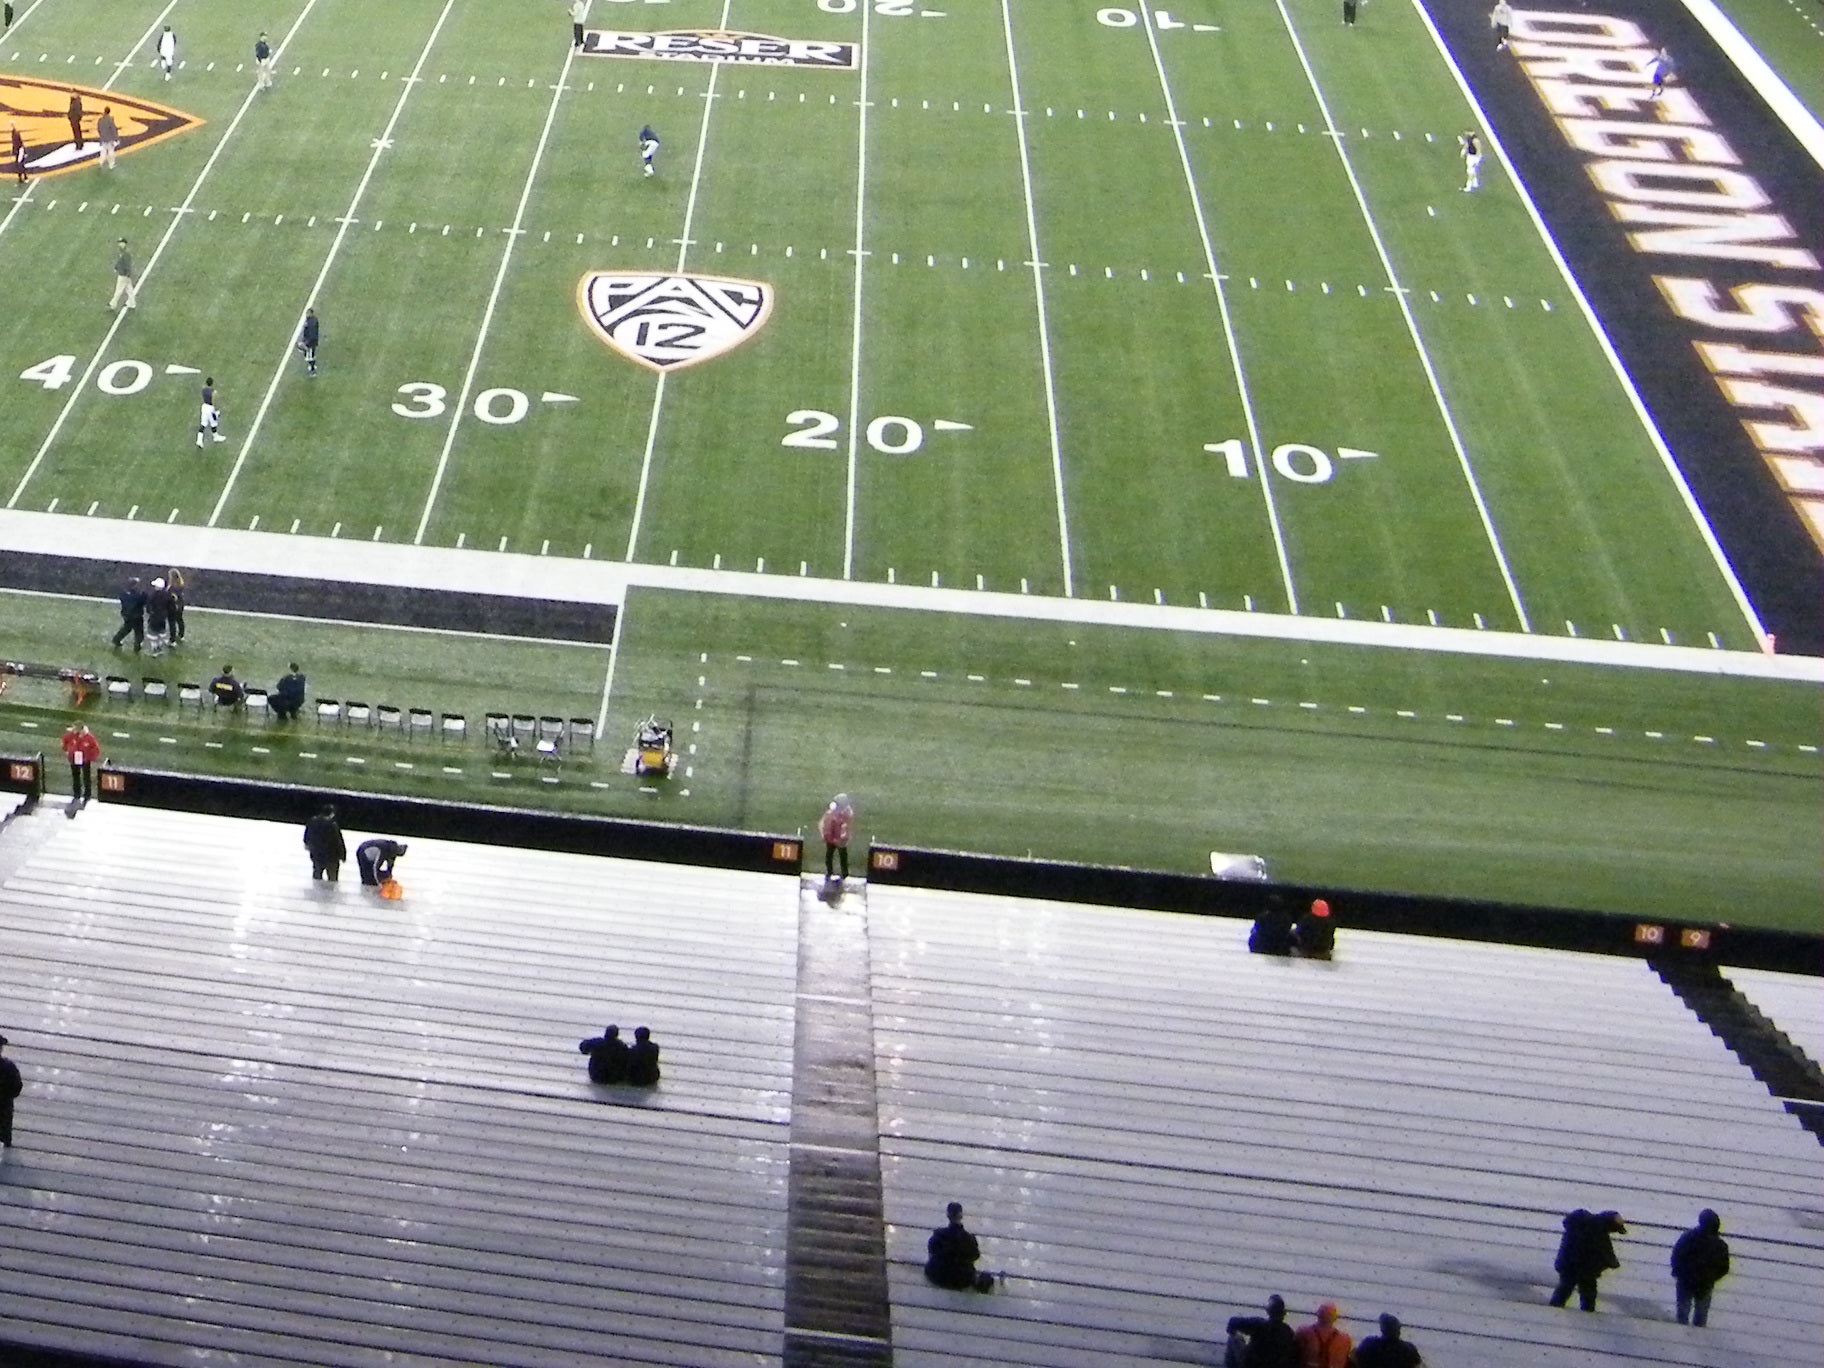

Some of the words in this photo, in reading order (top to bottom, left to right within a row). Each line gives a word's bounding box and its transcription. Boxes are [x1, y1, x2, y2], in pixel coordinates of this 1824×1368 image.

[1096, 8, 1185, 31] 10
[591, 32, 846, 63] RESER
[1510, 9, 1822, 270] OREGON
[589, 276, 764, 330] PAC
[635, 321, 706, 350] 12
[19, 354, 152, 396] 40
[391, 381, 529, 425] 30
[782, 408, 924, 455] 20
[1203, 438, 1337, 484] 10
[15, 765, 30, 779] 12
[107, 776, 118, 789] 11
[780, 845, 791, 859] 11
[878, 853, 894, 867] 10
[1641, 926, 1658, 940] 10
[1690, 931, 1701, 947] 9
